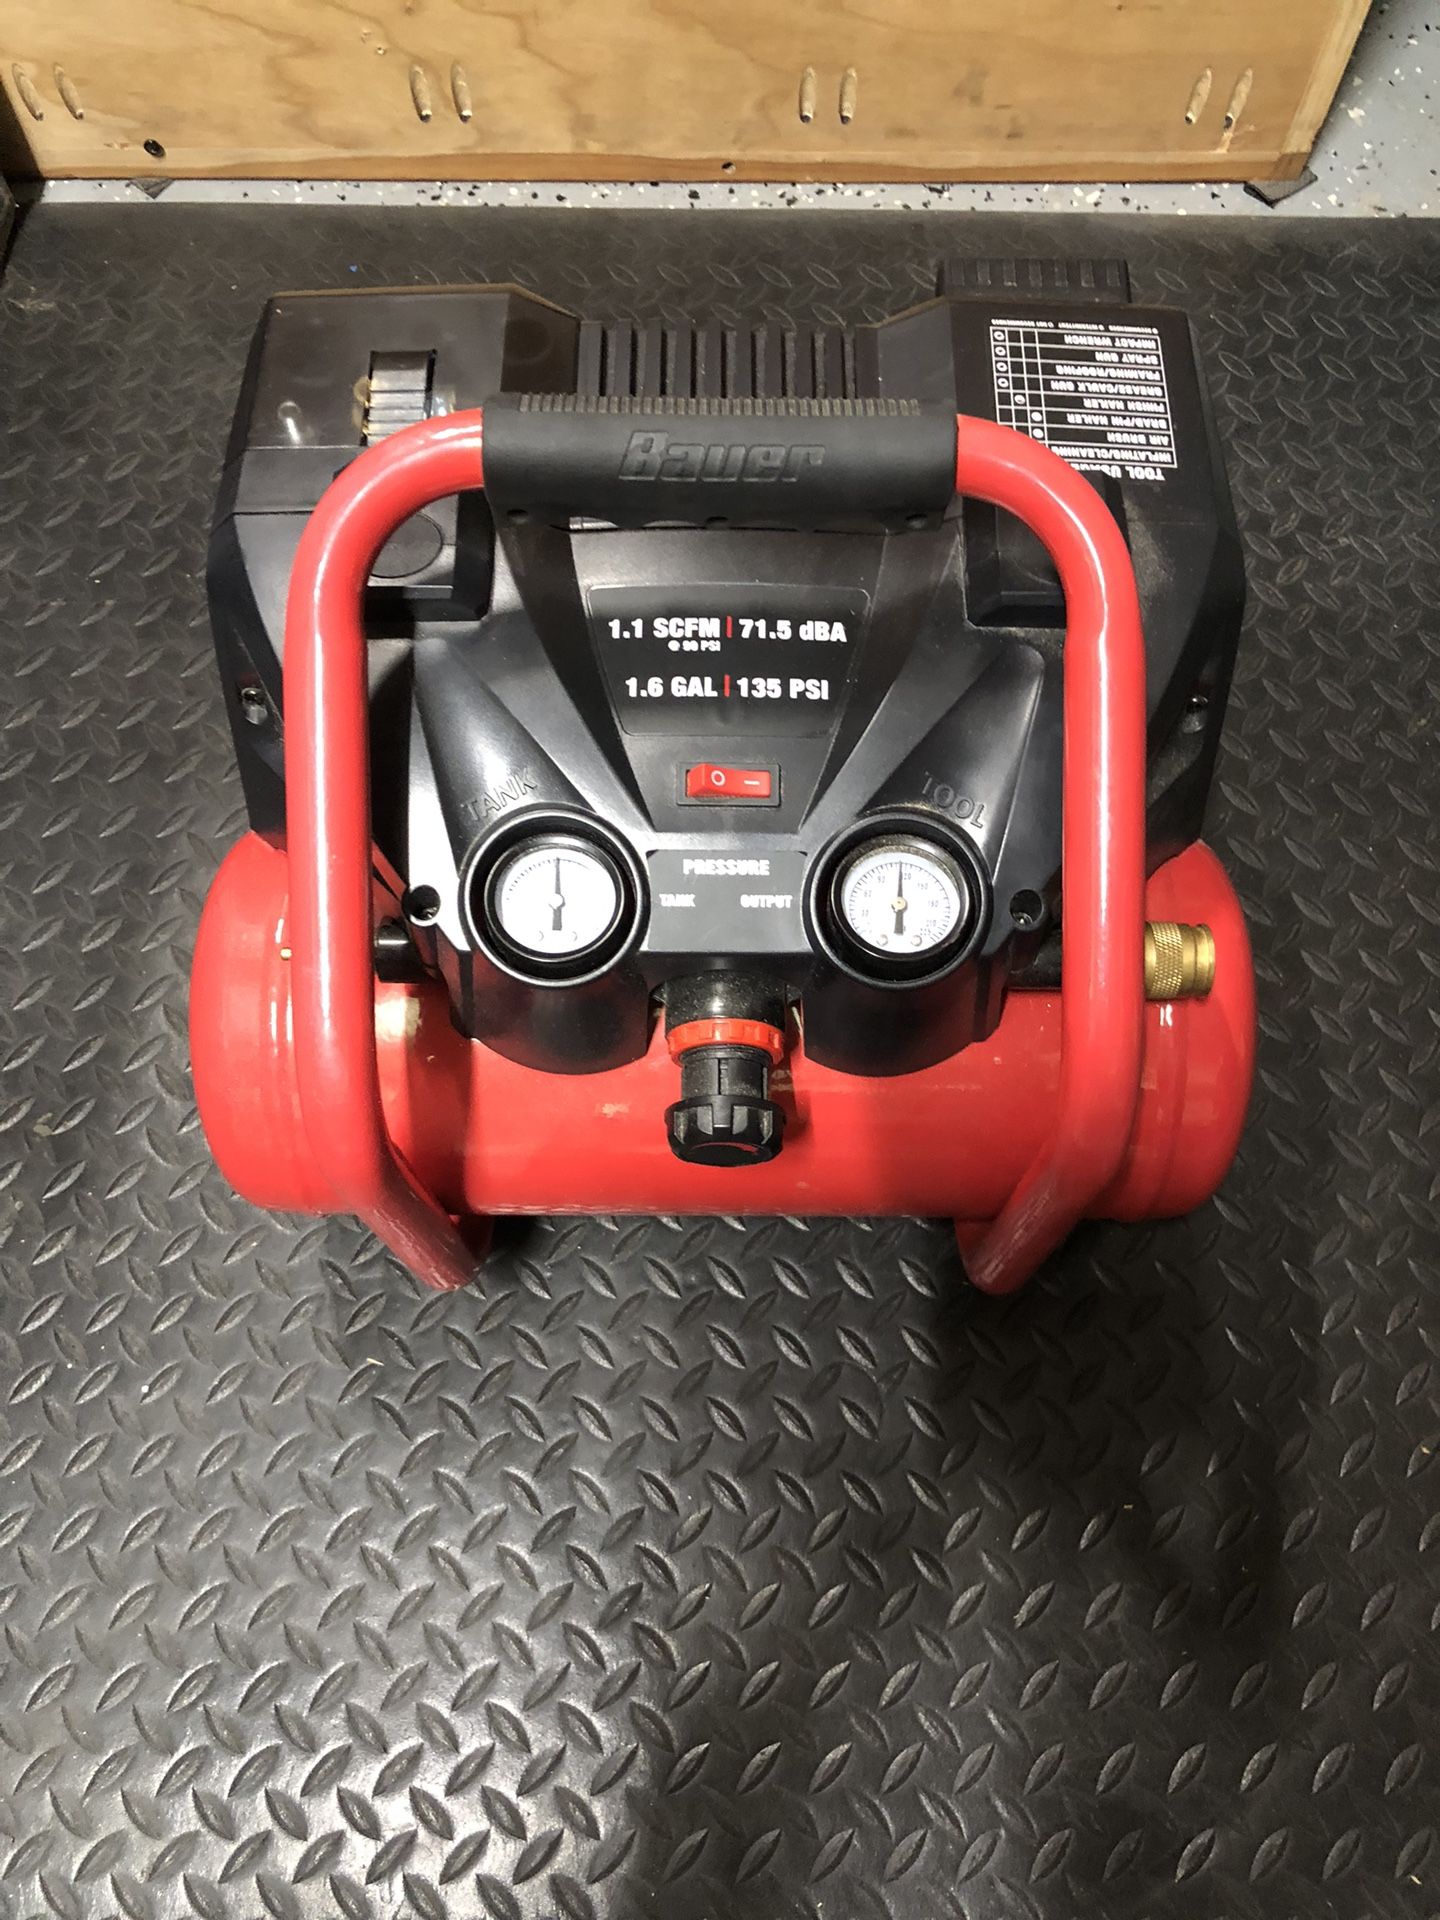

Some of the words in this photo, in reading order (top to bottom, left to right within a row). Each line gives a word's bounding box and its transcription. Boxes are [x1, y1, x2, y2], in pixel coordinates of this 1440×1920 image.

[1064, 334, 1113, 347] WRENCH
[1114, 336, 1156, 349] IMPACT
[1095, 352, 1119, 362] GUN
[1122, 353, 1159, 365] SPRAY
[1050, 380, 1075, 391] GUN
[1083, 398, 1125, 410] NAILER
[1066, 413, 1109, 425] NAILER
[1111, 416, 1168, 430] BRAD/PIN
[1107, 432, 1147, 445] BRUSH
[1149, 435, 1169, 446] AIR
[618, 429, 826, 482] Bauer
[1125, 466, 1165, 481] TOOL
[608, 618, 643, 639] 1.1
[653, 617, 721, 639] SCFM
[739, 618, 792, 640] 71.5
[799, 620, 848, 643] dBA
[700, 640, 721, 651] PSI
[625, 676, 664, 698] 1.6
[671, 676, 718, 697] GAL
[737, 677, 782, 698] 135
[789, 678, 830, 700] PSI
[465, 767, 538, 821] TANK
[922, 770, 985, 829] TOOL
[682, 858, 770, 876] PRESSURE
[659, 893, 696, 907] TANK
[740, 894, 793, 908] OUTPUT
